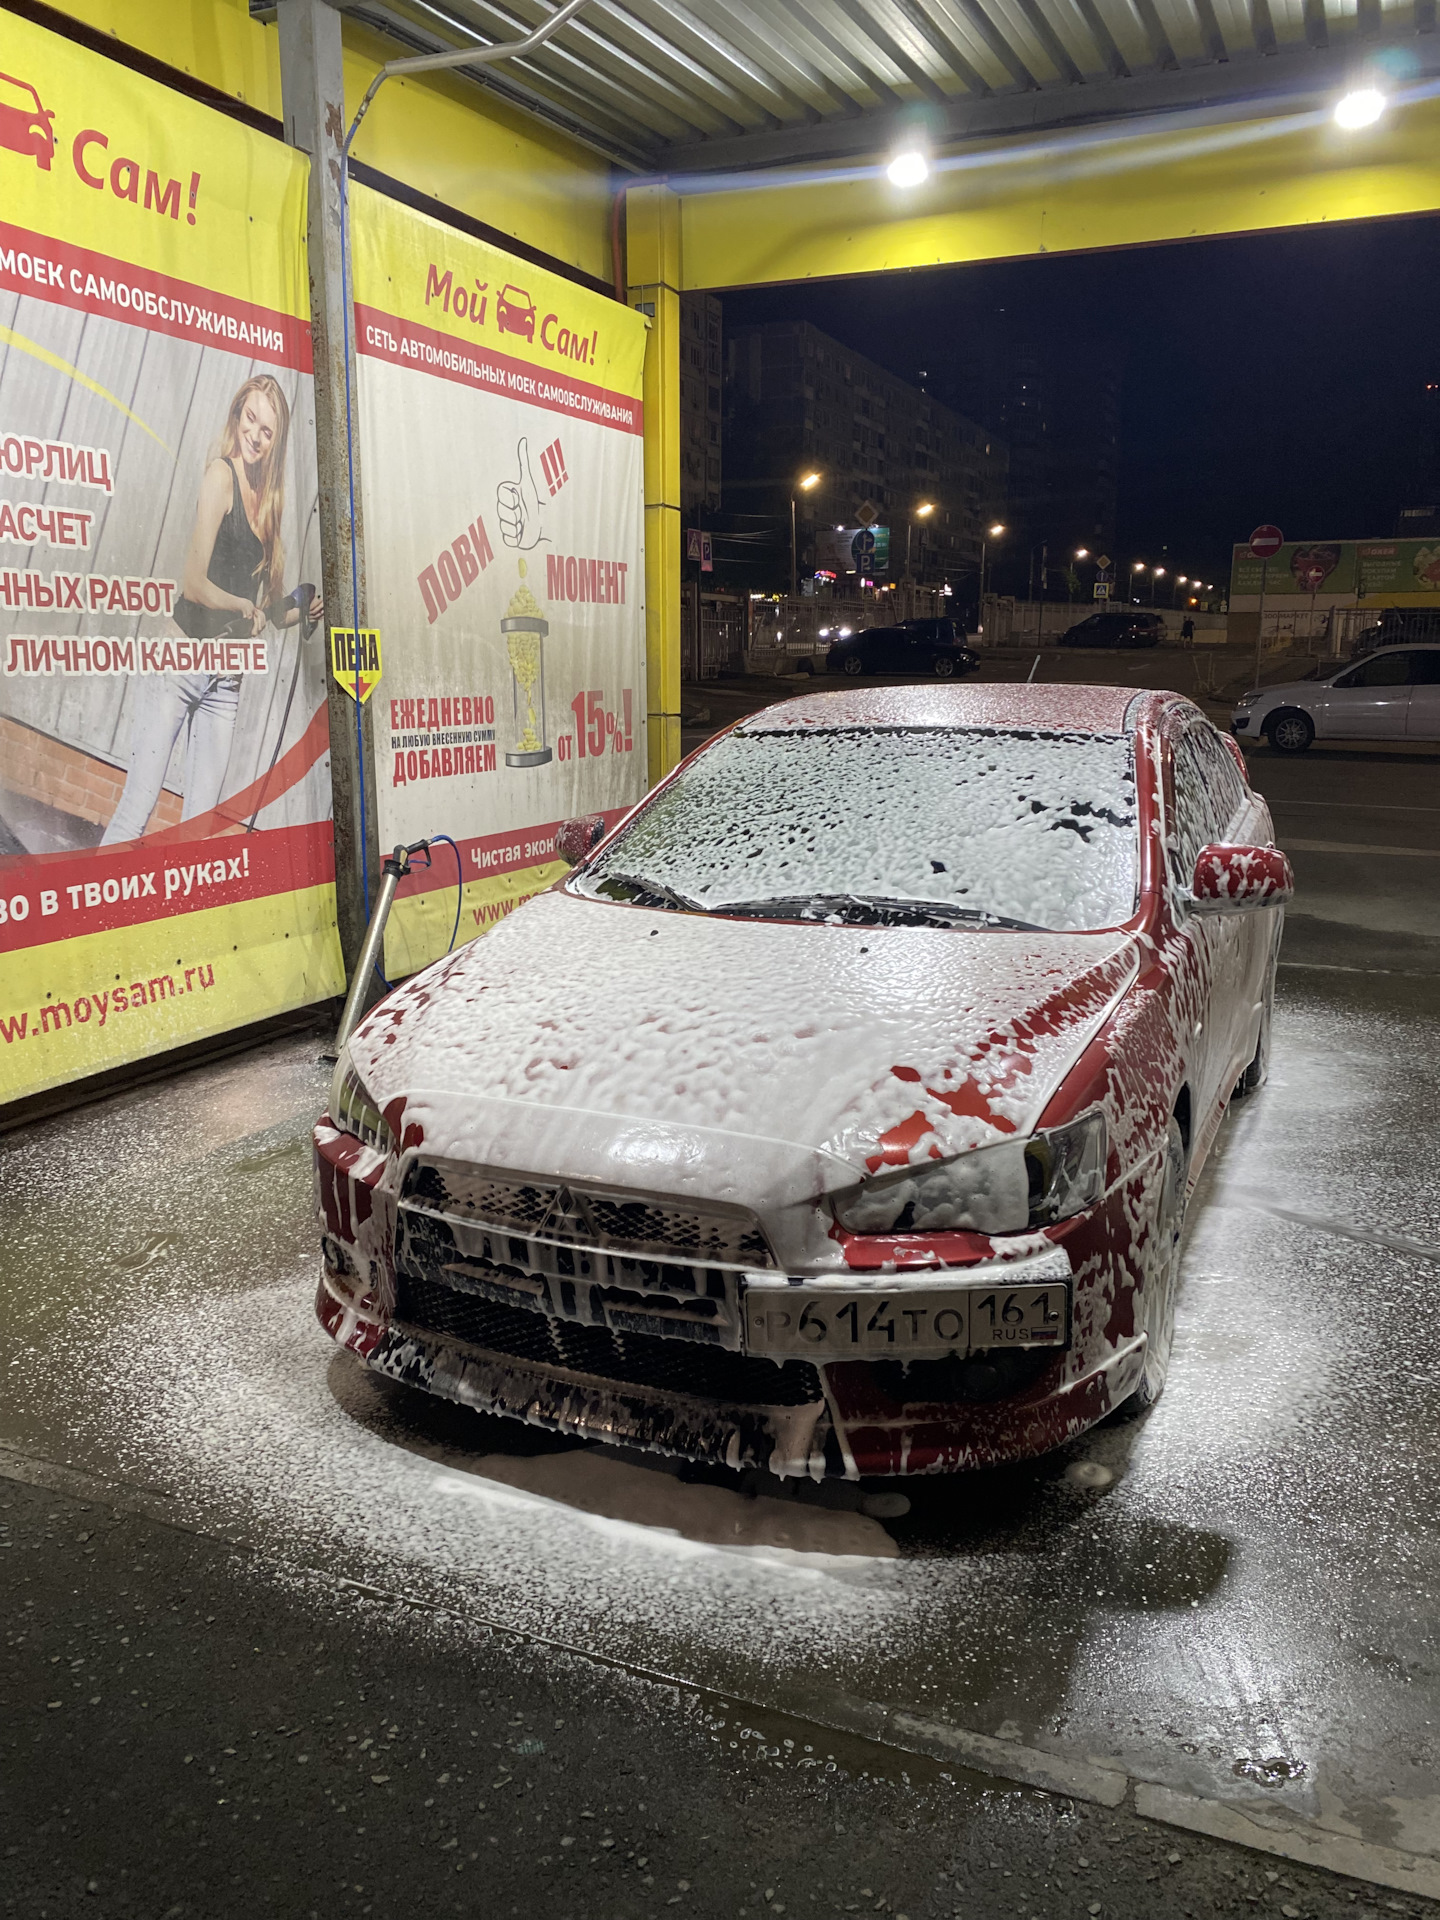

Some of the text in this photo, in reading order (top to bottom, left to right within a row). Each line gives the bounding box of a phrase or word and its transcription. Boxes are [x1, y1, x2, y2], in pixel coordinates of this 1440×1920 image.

[72, 129, 201, 226] Сам!
[0, 246, 284, 353] МОЕК САМООБСЛУЖИВАНИЯ
[425, 263, 598, 366] Мой Сам!
[366, 325, 633, 426] СЕТЬ АВТОМОБИЛЬНЫХ МОЕК САМООБСЛУЖИВАНИЯ
[540, 438, 569, 497] !!!
[417, 515, 494, 625] ЛОВИ
[546, 554, 628, 605] МОМЕНТ
[89, 578, 174, 613] РАБОТ
[8, 638, 267, 672] ЛИЧНОМ КАБИНЕТЕ
[334, 633, 380, 671] ПЕНА
[390, 696, 495, 732] ЕЖЕДНЕВНО
[571, 689, 633, 758] 15%!
[391, 729, 496, 749] НА ЛЮБУЮ ВНЕСЕННУЮ СУММУ
[393, 744, 496, 788] ДОБАВЛЯЕМ
[471, 846, 521, 869] Чистая
[40, 889, 59, 916] в
[67, 872, 156, 910] твоих
[164, 848, 250, 899] руках!
[976, 1291, 1051, 1327] 161
[992, 1327, 1030, 1341] RUS
